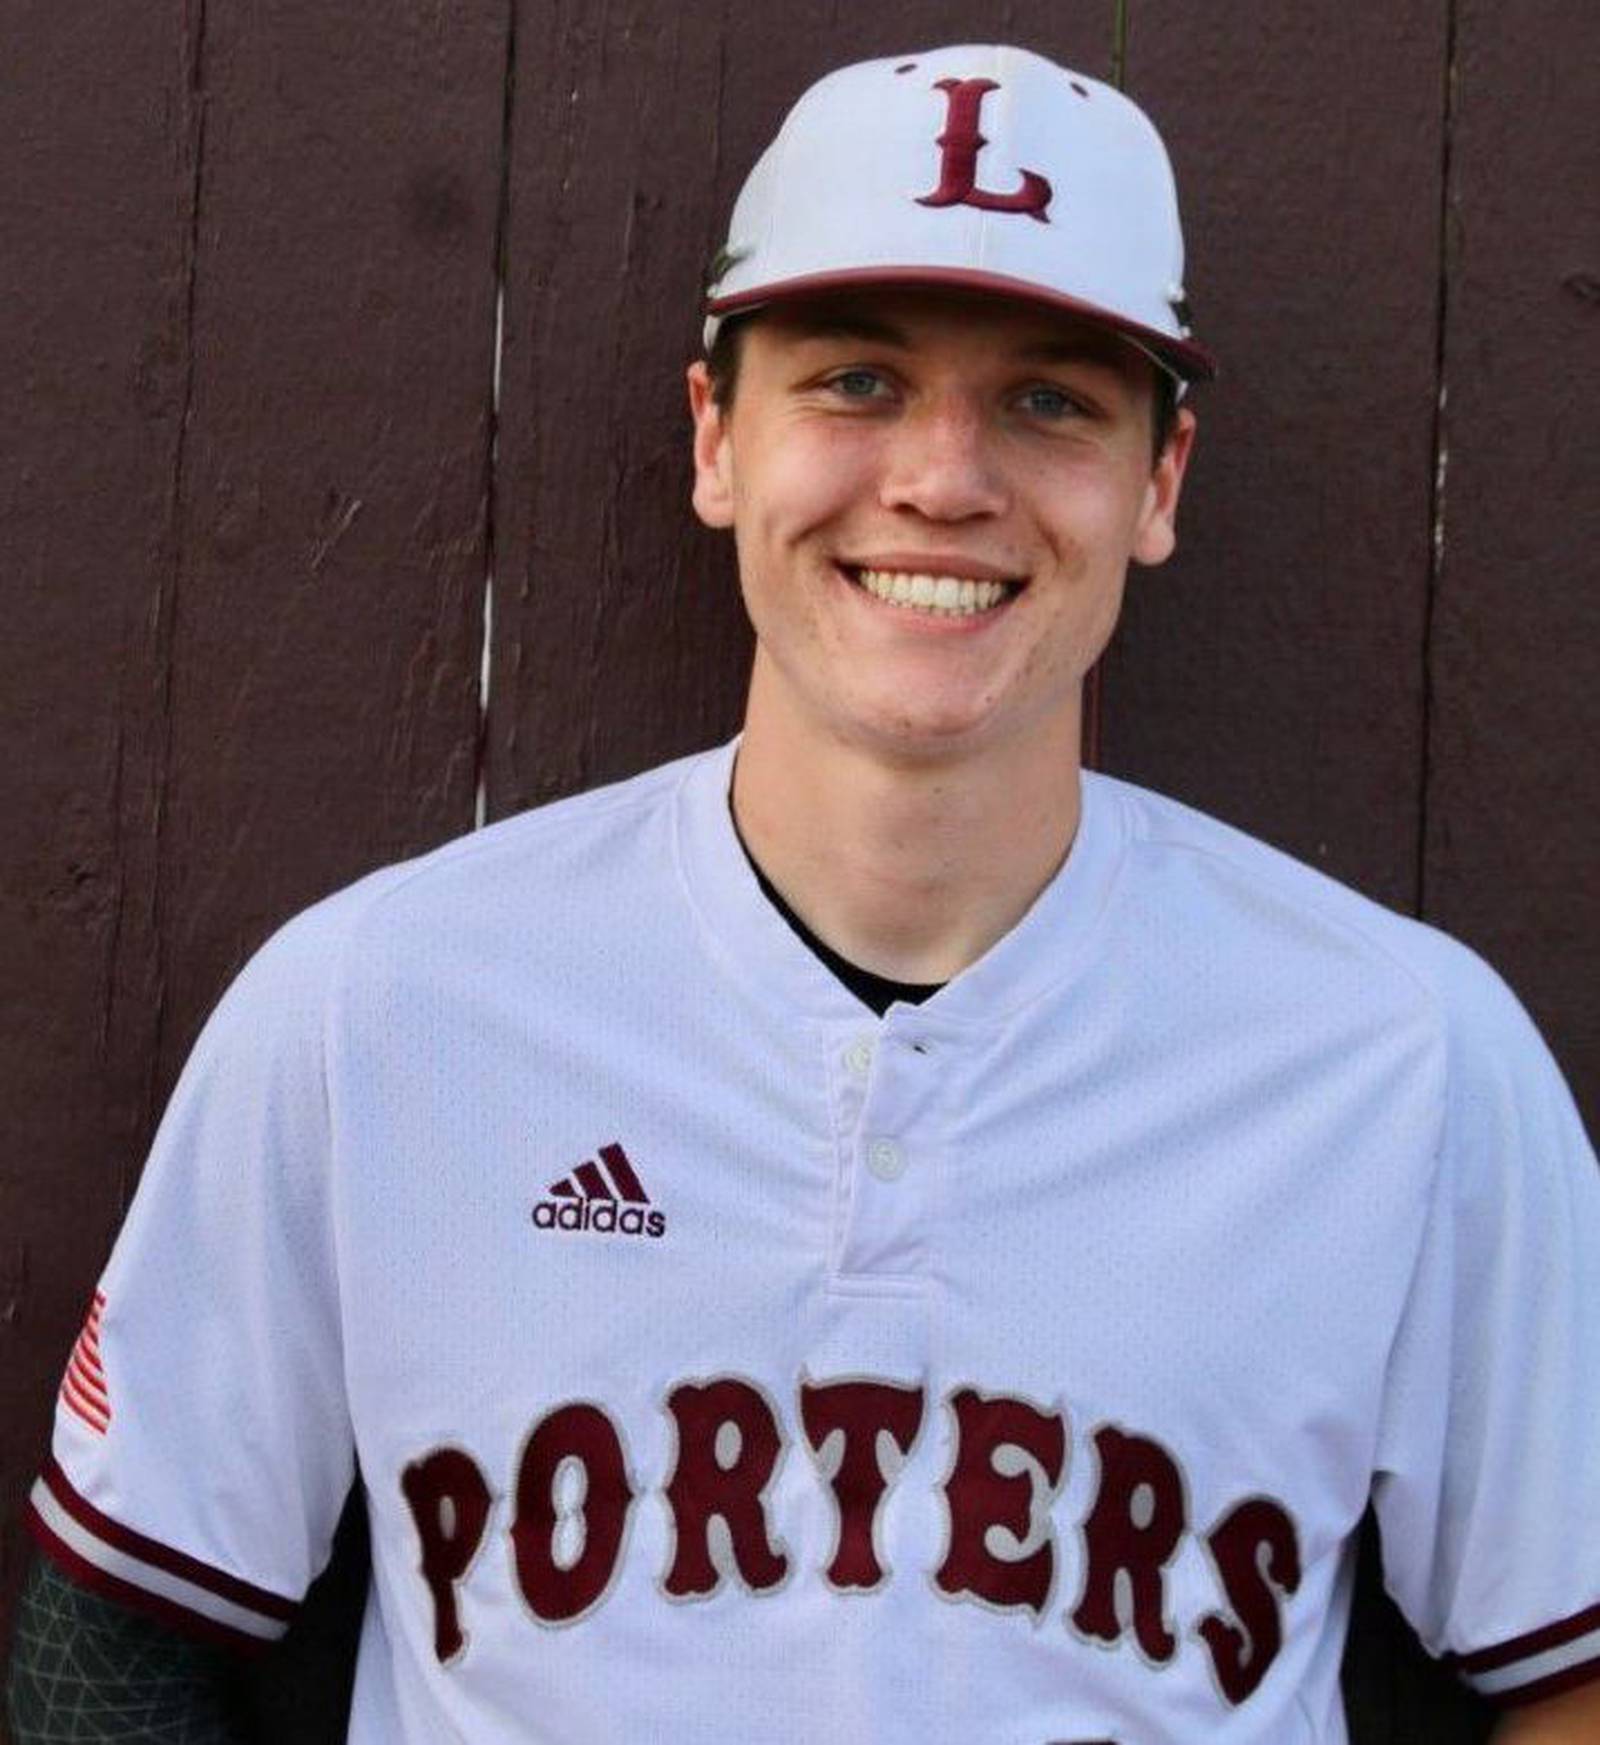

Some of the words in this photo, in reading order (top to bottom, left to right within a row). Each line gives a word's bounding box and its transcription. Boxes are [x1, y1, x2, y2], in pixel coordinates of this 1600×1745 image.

[914, 77, 1053, 225] L
[531, 1196, 667, 1238] adidas
[399, 1376, 1304, 1708] PORTERS
